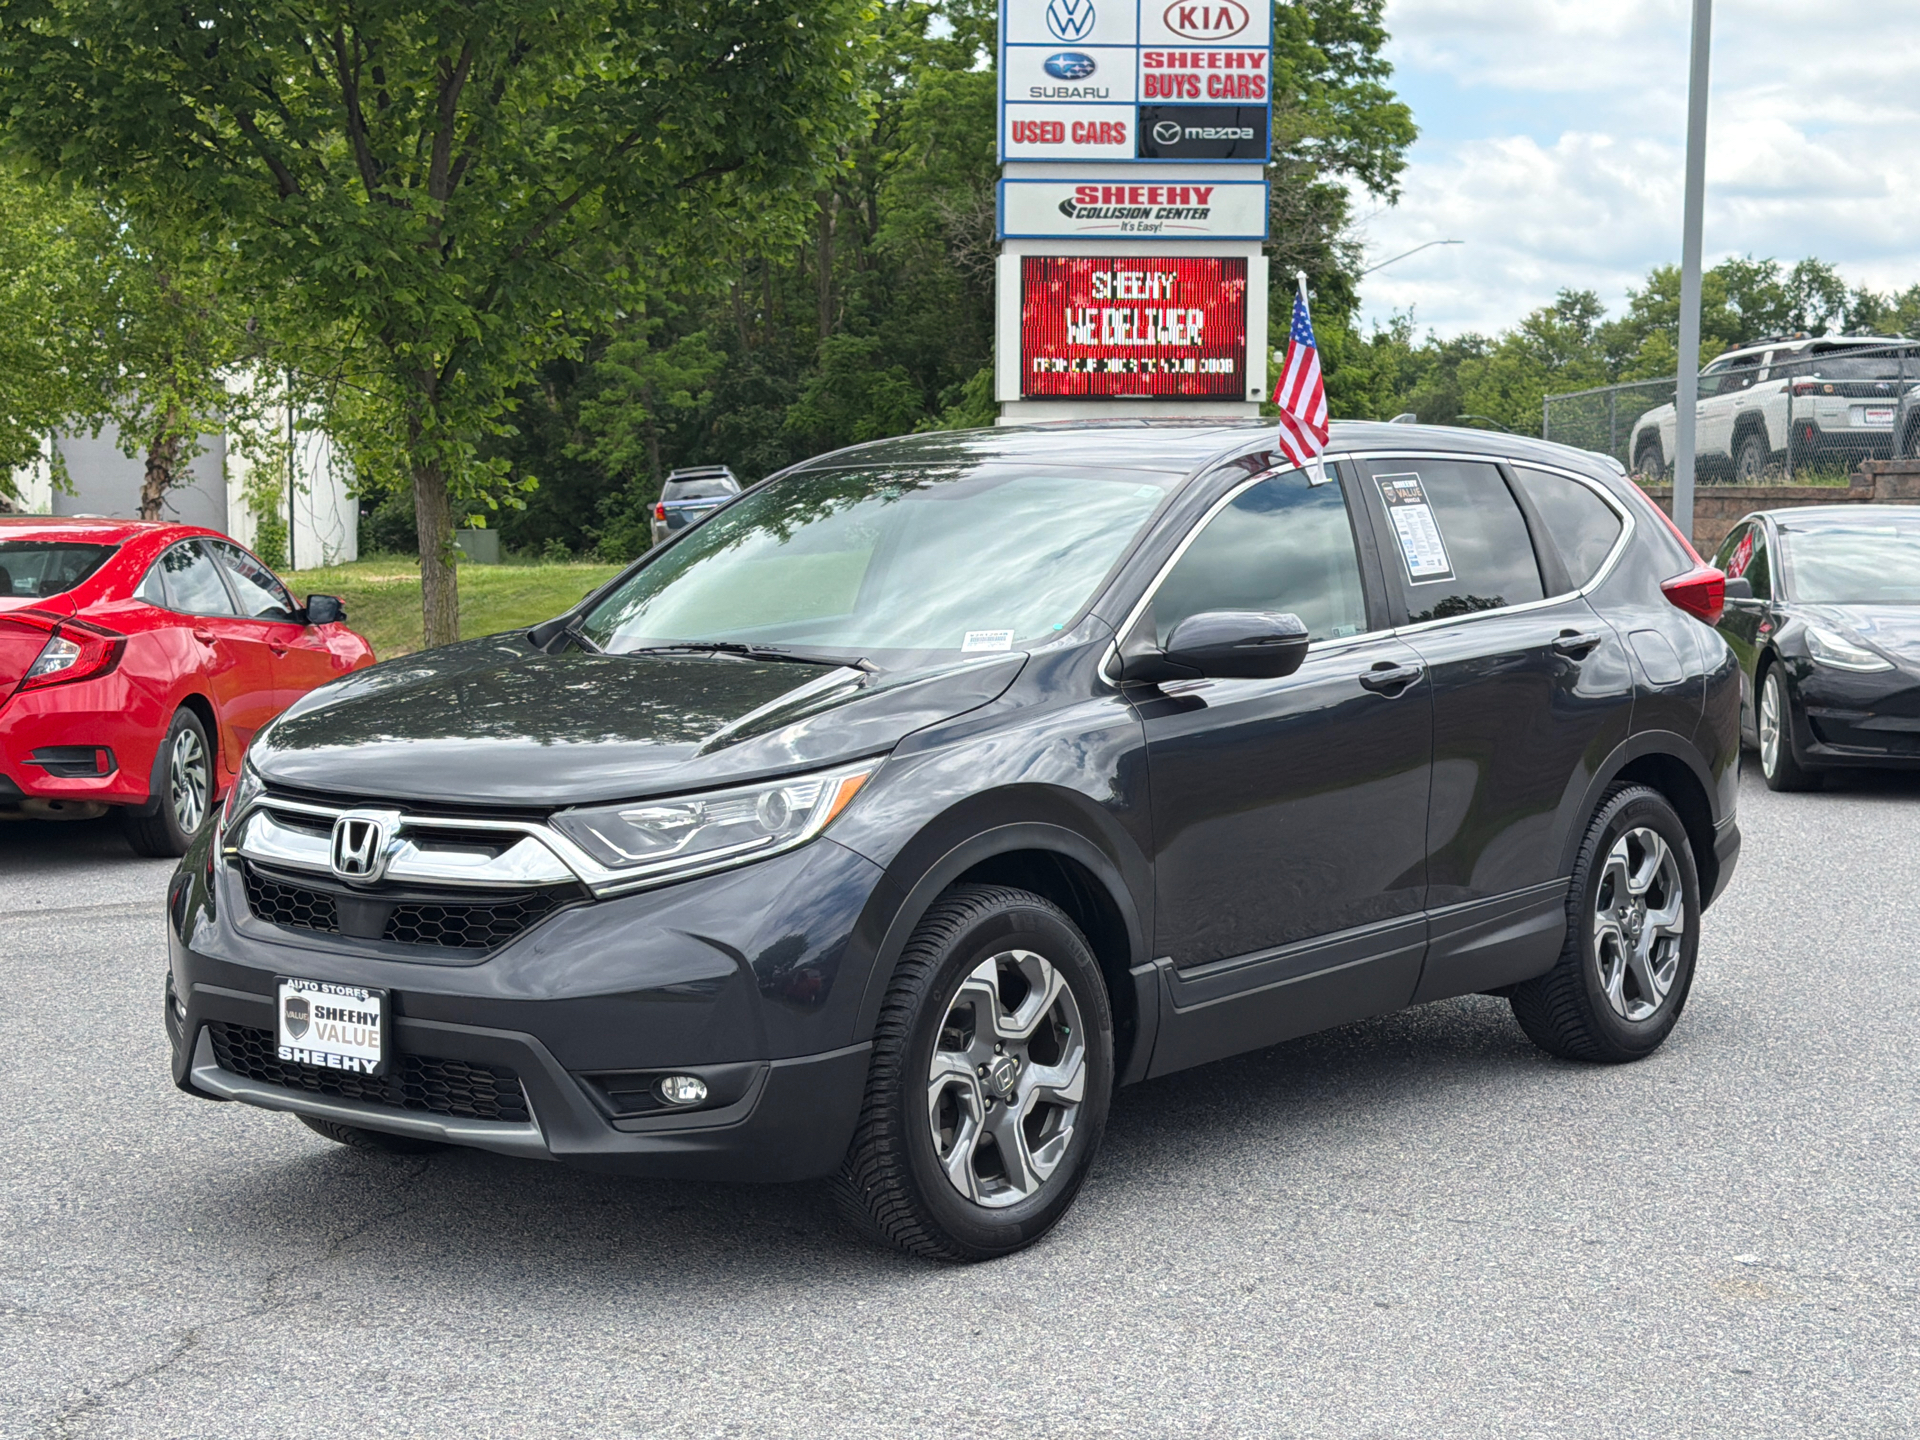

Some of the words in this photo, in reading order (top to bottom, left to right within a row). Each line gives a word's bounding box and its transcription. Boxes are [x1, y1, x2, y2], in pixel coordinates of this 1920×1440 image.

[1179, 7, 1234, 30] KIA
[1143, 52, 1266, 69] SHEEHY
[1030, 87, 1109, 98] SUBARU
[1144, 74, 1200, 98] BUYS
[1207, 74, 1265, 99] CARS
[1012, 121, 1065, 143] USED
[1072, 121, 1126, 144] CARS
[1185, 127, 1254, 139] mazda
[1075, 186, 1214, 205] SHEEHY
[1075, 207, 1153, 219] COLLISION
[1154, 208, 1211, 220] CENTER
[1121, 221, 1135, 231] It's
[1137, 222, 1162, 233] Easy!
[1396, 487, 1422, 498] VALUE
[286, 979, 319, 992] AUTO
[321, 984, 370, 998] STORES
[285, 1010, 309, 1021] VALUE
[314, 1005, 380, 1027] SHEEHY
[315, 1021, 380, 1048] VALUE
[278, 1046, 378, 1074] SHEEHY
